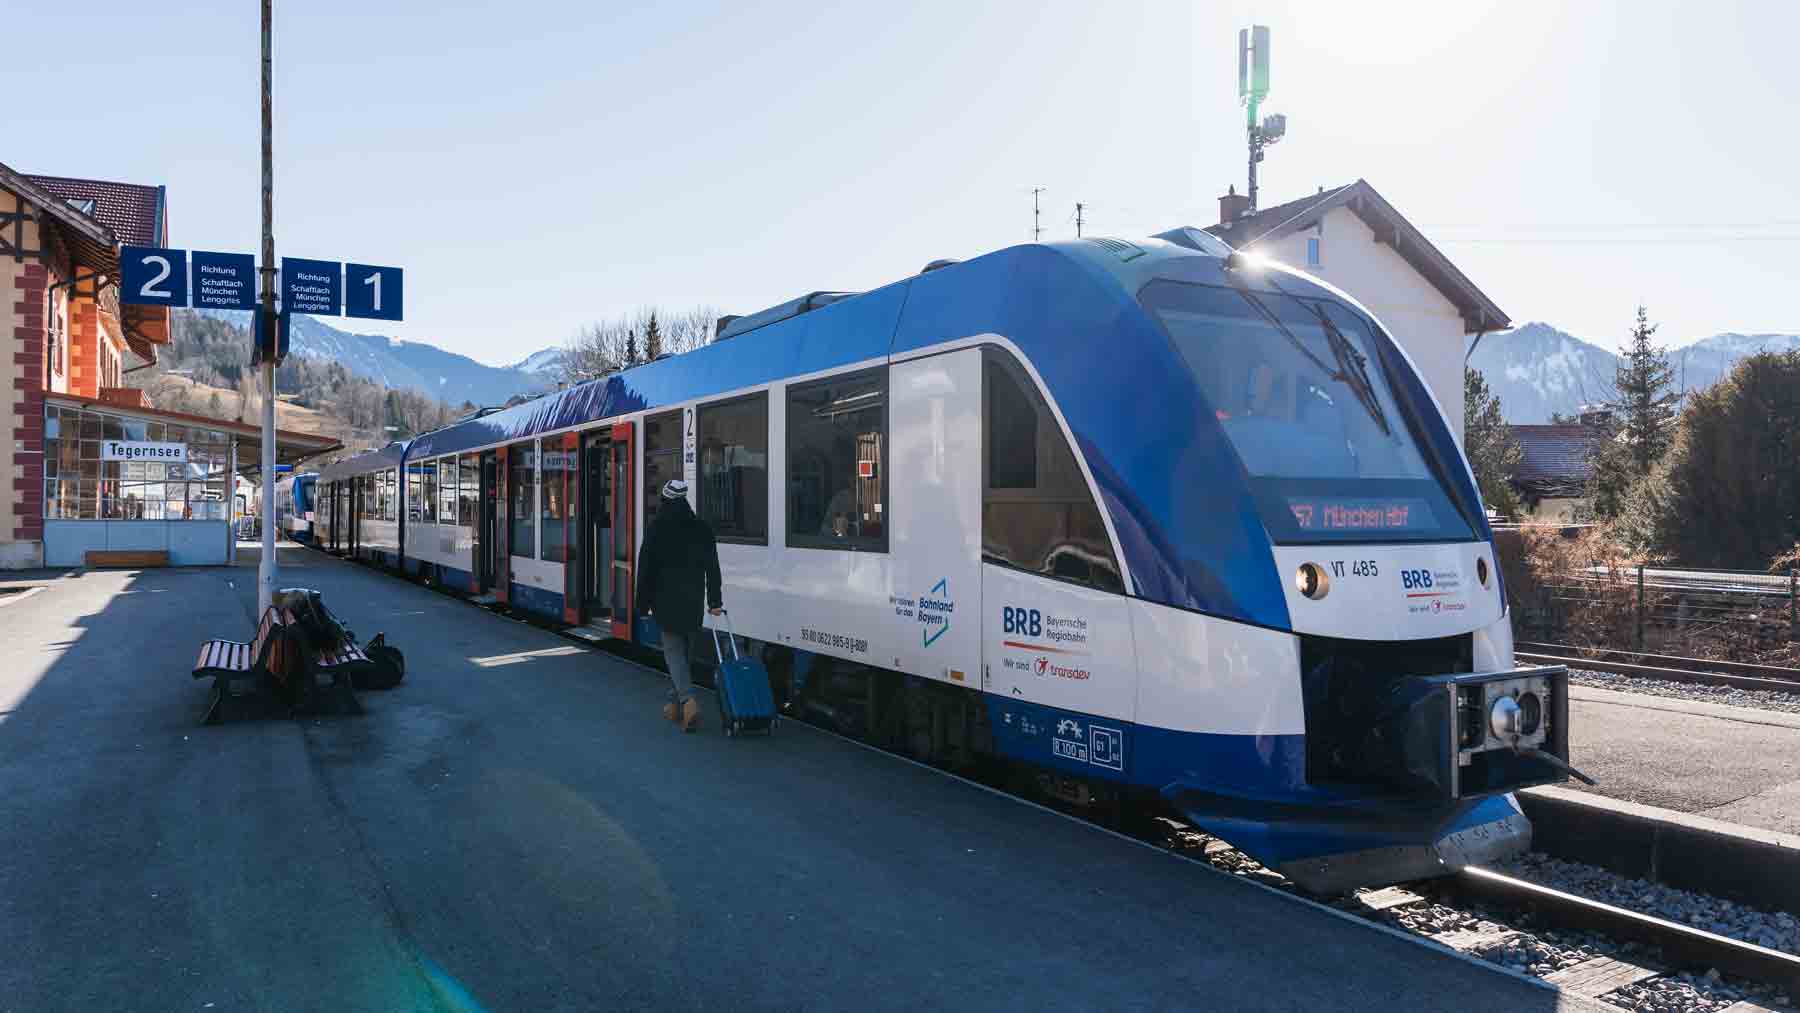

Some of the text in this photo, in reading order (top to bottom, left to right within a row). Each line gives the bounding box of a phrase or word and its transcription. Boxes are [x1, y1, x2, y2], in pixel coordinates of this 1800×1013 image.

[139, 255, 172, 297] 2
[201, 265, 236, 276] Richtung
[297, 272, 330, 284] Richtung
[201, 278, 243, 287] Schaftlach
[290, 284, 330, 294] Schaftlach
[201, 286, 238, 295] München
[295, 293, 330, 302] München
[364, 272, 382, 310] 1
[201, 295, 240, 304] Lenggries
[293, 302, 330, 311] Lenggries
[687, 408, 693, 436] 2
[110, 443, 180, 459] Tegernsee
[1323, 504, 1384, 528] München
[1386, 504, 1408, 528] Hbf
[1331, 560, 1378, 577] VT 485
[1401, 569, 1433, 589] BRB
[903, 608, 913, 617] das
[919, 597, 954, 613] Bahnland
[918, 610, 943, 625] Bayern
[1003, 606, 1041, 637] BRB
[1046, 615, 1087, 629] Bayerische
[1046, 629, 1086, 643] Regiobahn
[1003, 658, 1090, 680] Wir sind transdev
[1062, 743, 1077, 757] 100
[1078, 748, 1087, 760] m
